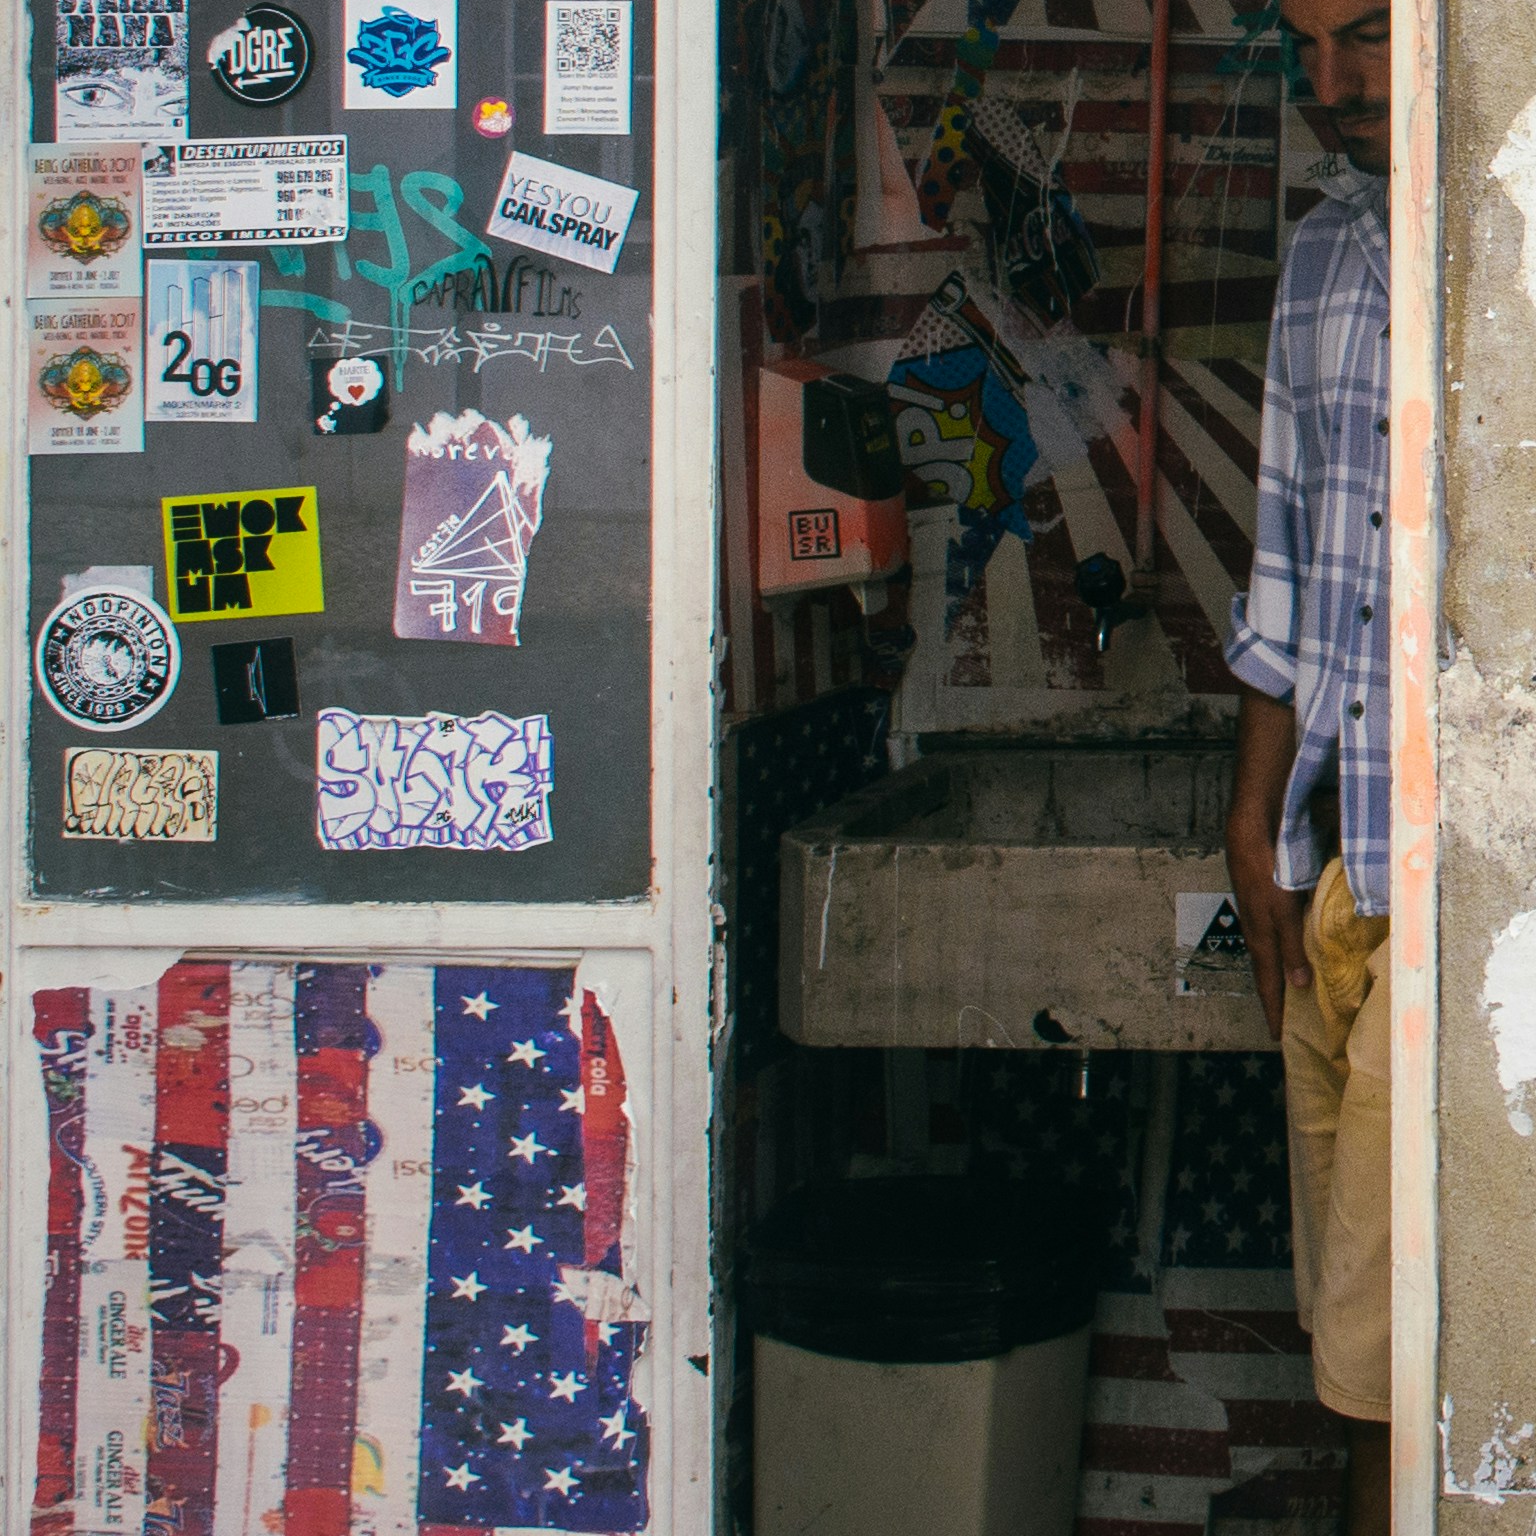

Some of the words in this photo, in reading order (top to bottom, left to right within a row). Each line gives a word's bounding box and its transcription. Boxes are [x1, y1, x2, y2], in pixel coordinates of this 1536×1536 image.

[184, 140, 341, 159] DESENTUPIMENTOS
[151, 231, 224, 243] PREÇOS
[171, 495, 308, 541] EWOK
[590, 1057, 610, 1096] cola
[109, 1291, 127, 1347] GINGER
[109, 1350, 127, 1380] ALE
[107, 1430, 123, 1489] GINGER
[106, 1491, 123, 1525] ALE
